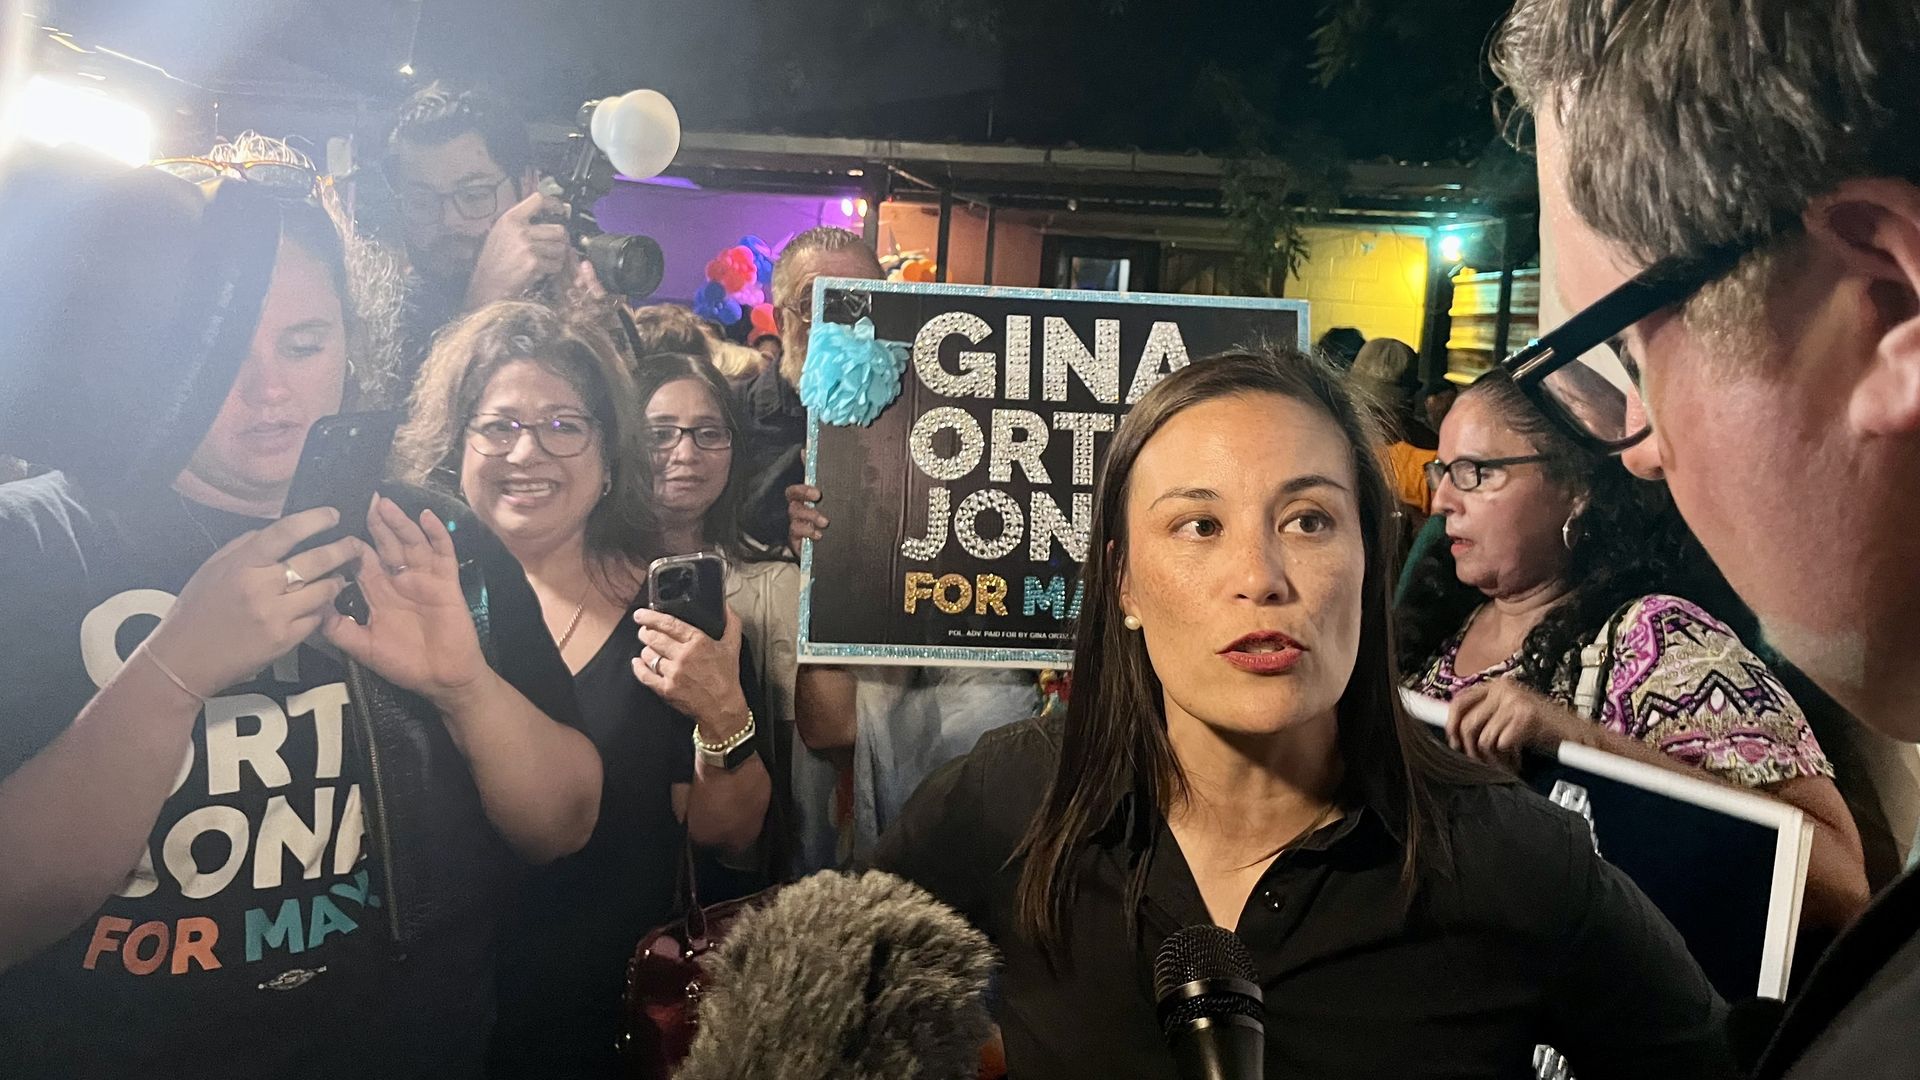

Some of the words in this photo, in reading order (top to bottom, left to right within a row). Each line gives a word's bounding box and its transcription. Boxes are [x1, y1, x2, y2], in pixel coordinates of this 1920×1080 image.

[913, 311, 1192, 404] GINA
[909, 406, 1127, 486] ORT
[901, 487, 1093, 563] JON
[904, 572, 1008, 616] FOR
[984, 630, 1000, 638] PAID
[1030, 631, 1048, 639] GINA
[82, 914, 223, 977] FOR
